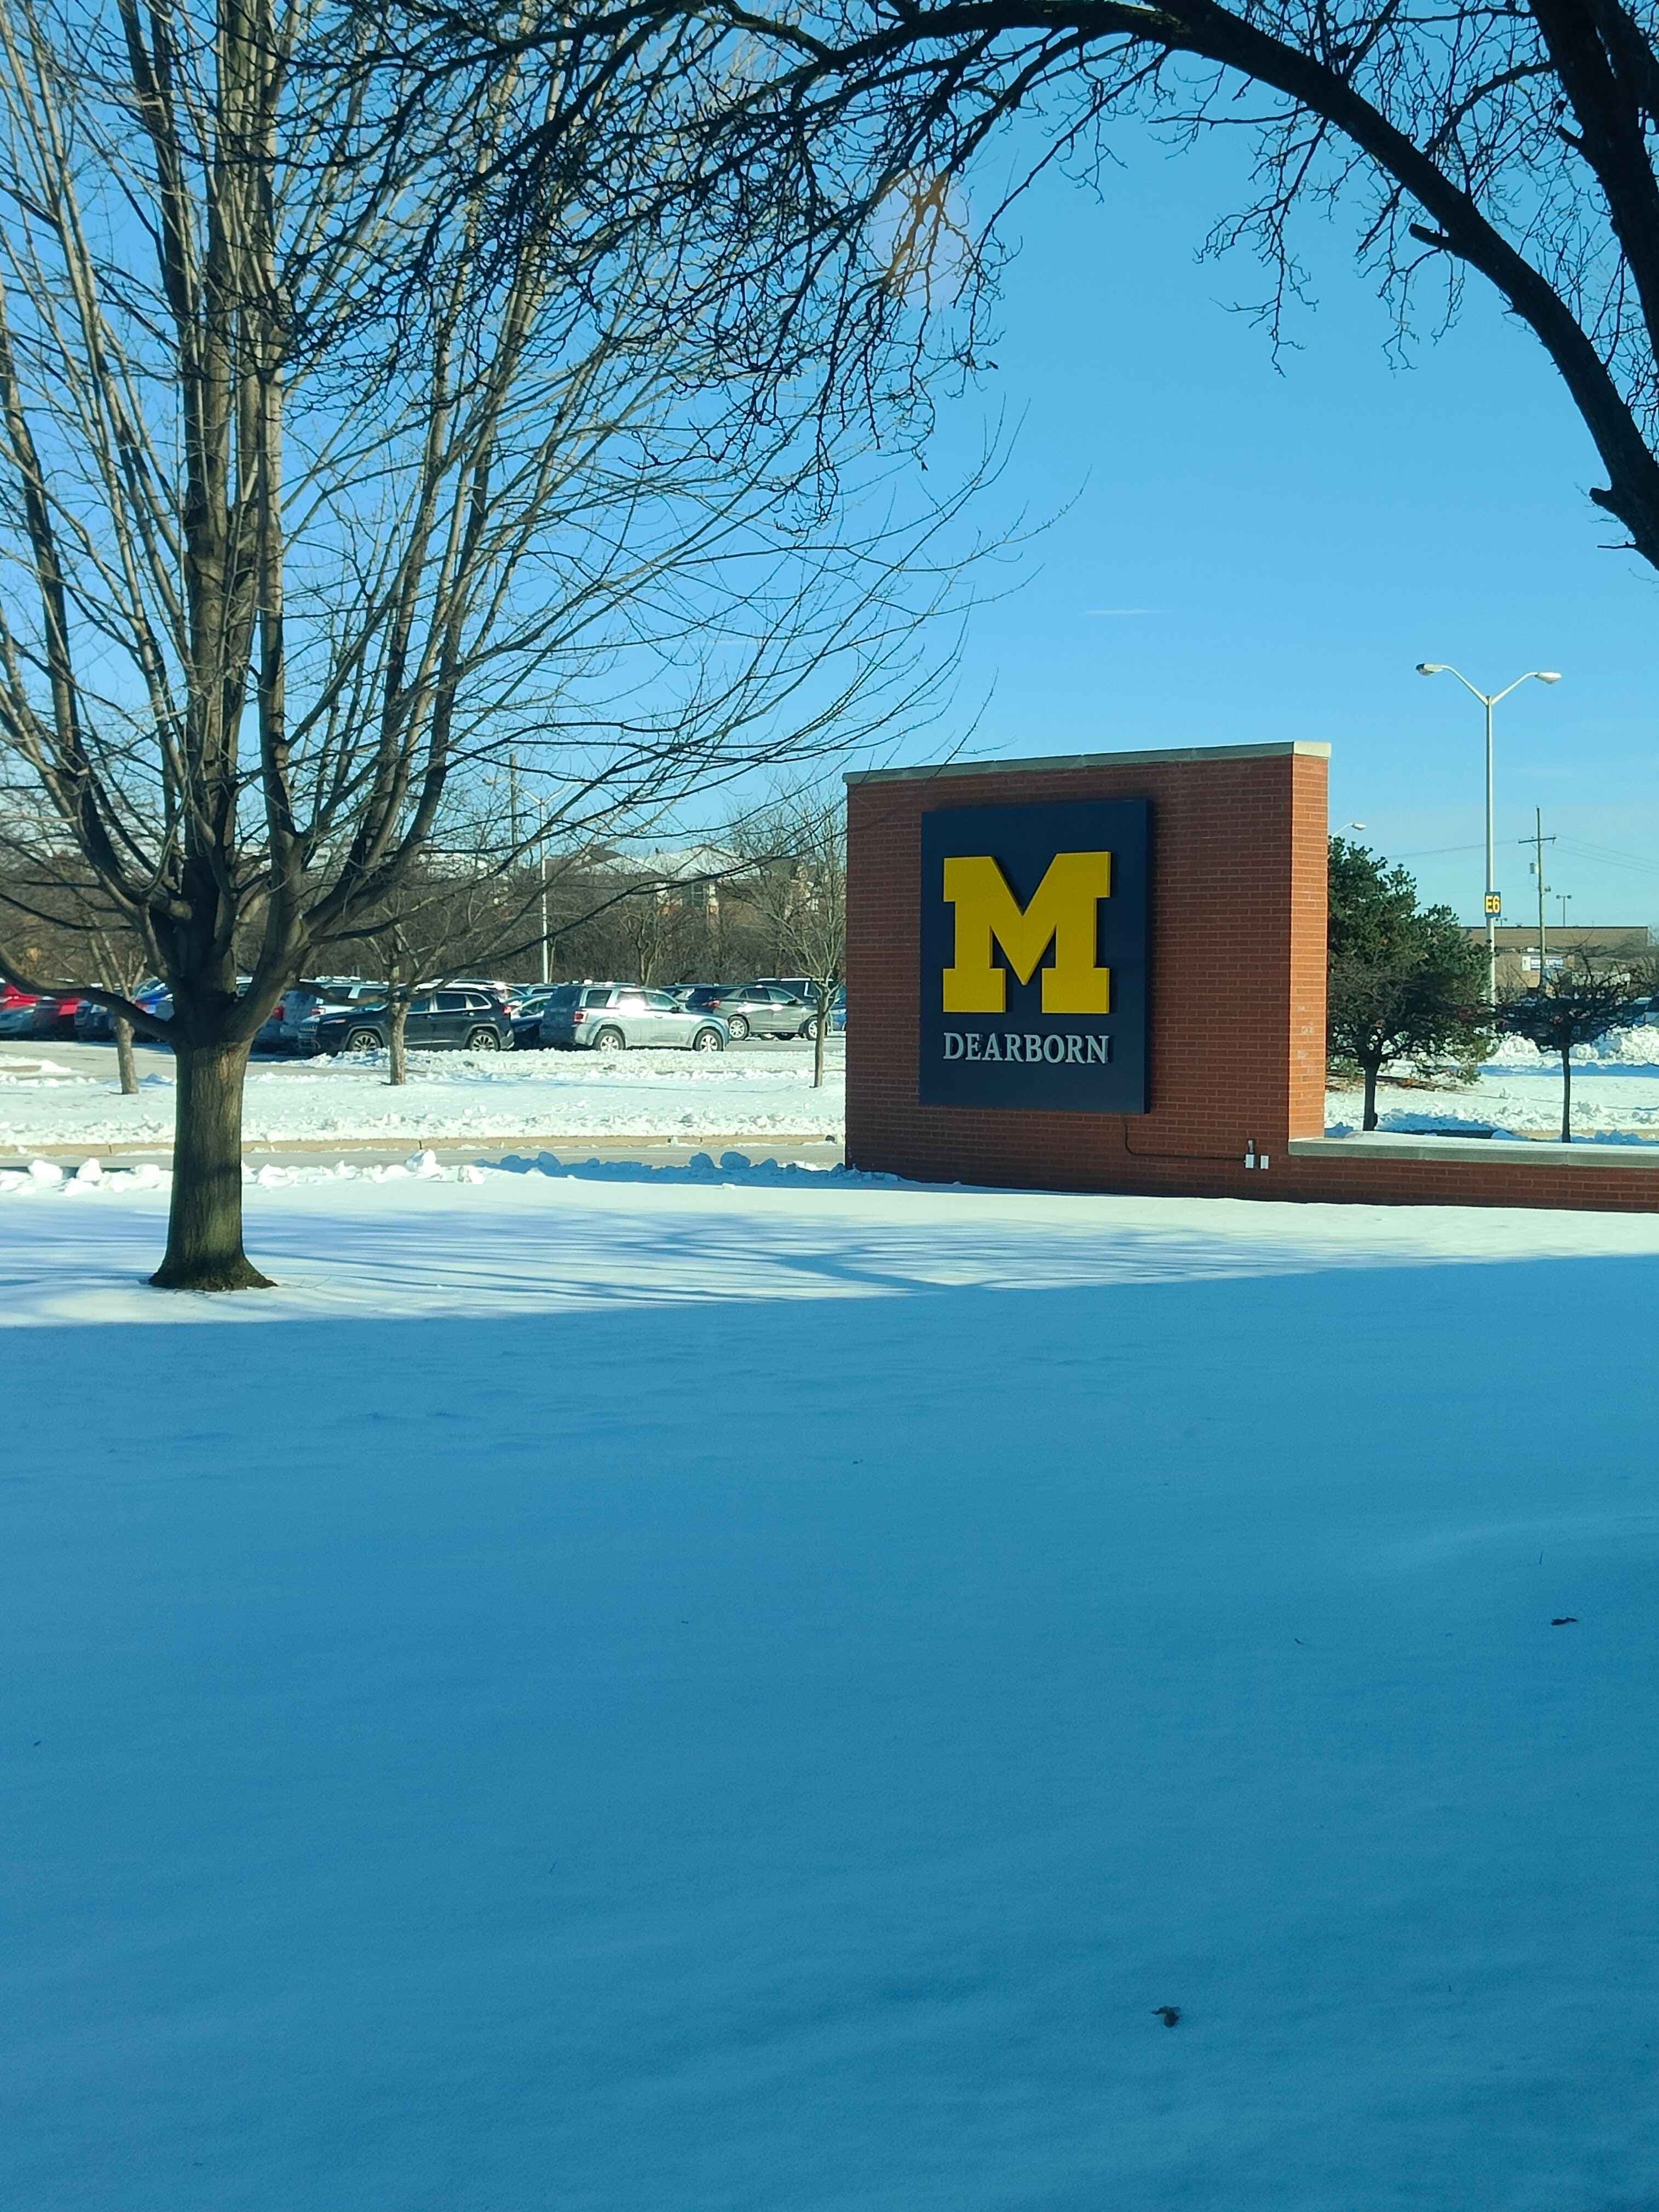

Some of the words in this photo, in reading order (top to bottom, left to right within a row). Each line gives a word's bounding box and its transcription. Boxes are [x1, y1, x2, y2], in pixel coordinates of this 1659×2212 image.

[1485, 895, 1500, 913] E6
[943, 851, 1110, 1014] M
[943, 1032, 1110, 1064] DEARBORN
